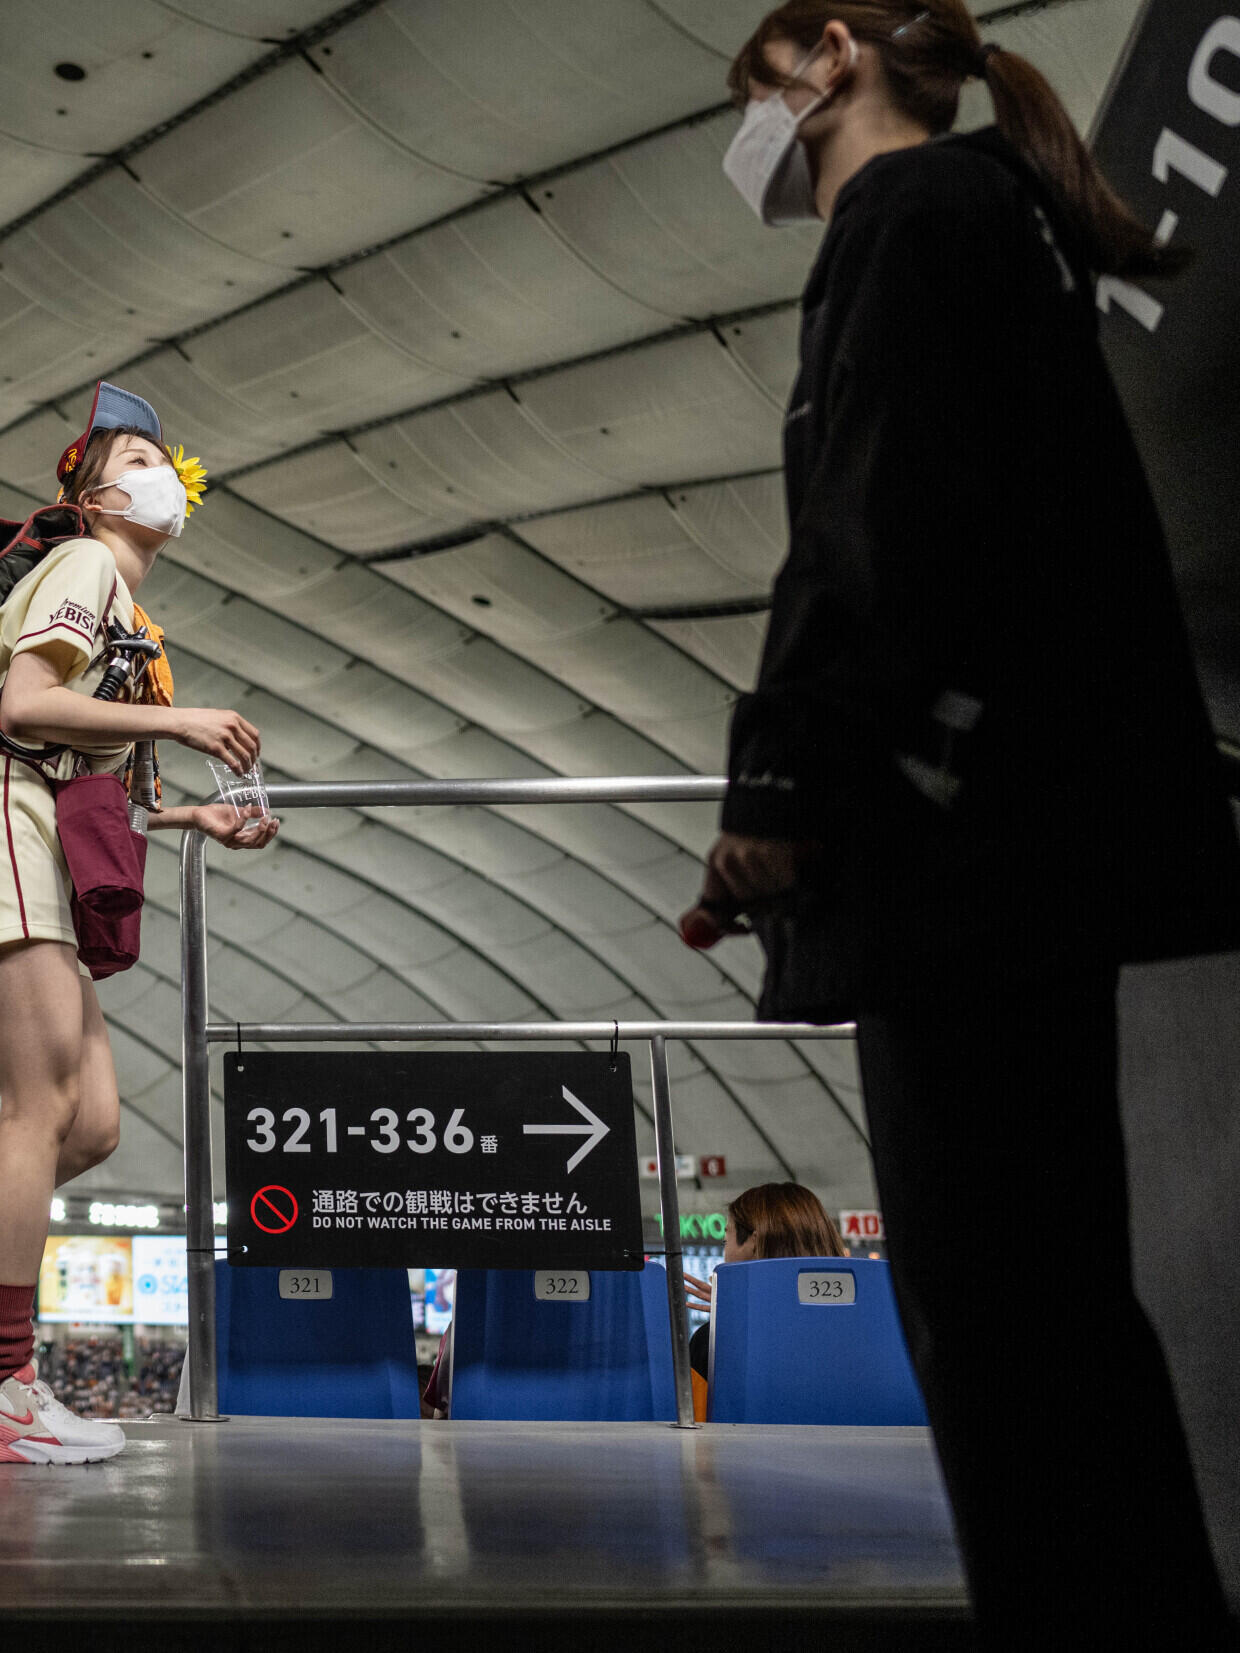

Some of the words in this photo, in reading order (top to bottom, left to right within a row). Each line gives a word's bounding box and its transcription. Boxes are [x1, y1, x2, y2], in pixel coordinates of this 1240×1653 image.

[312, 1190, 588, 1215] 通路での観戦はできません
[312, 1217, 331, 1228] DO
[336, 1217, 363, 1229] NOT
[367, 1217, 417, 1229] WATCH
[420, 1218, 449, 1229] THE
[452, 1218, 492, 1230] GAME
[496, 1218, 535, 1230] FROM
[539, 1219, 567, 1231] THE
[570, 1219, 612, 1231] AISLE
[290, 1277, 320, 1294] 321
[546, 1278, 578, 1295] 322
[810, 1280, 843, 1297] 323
